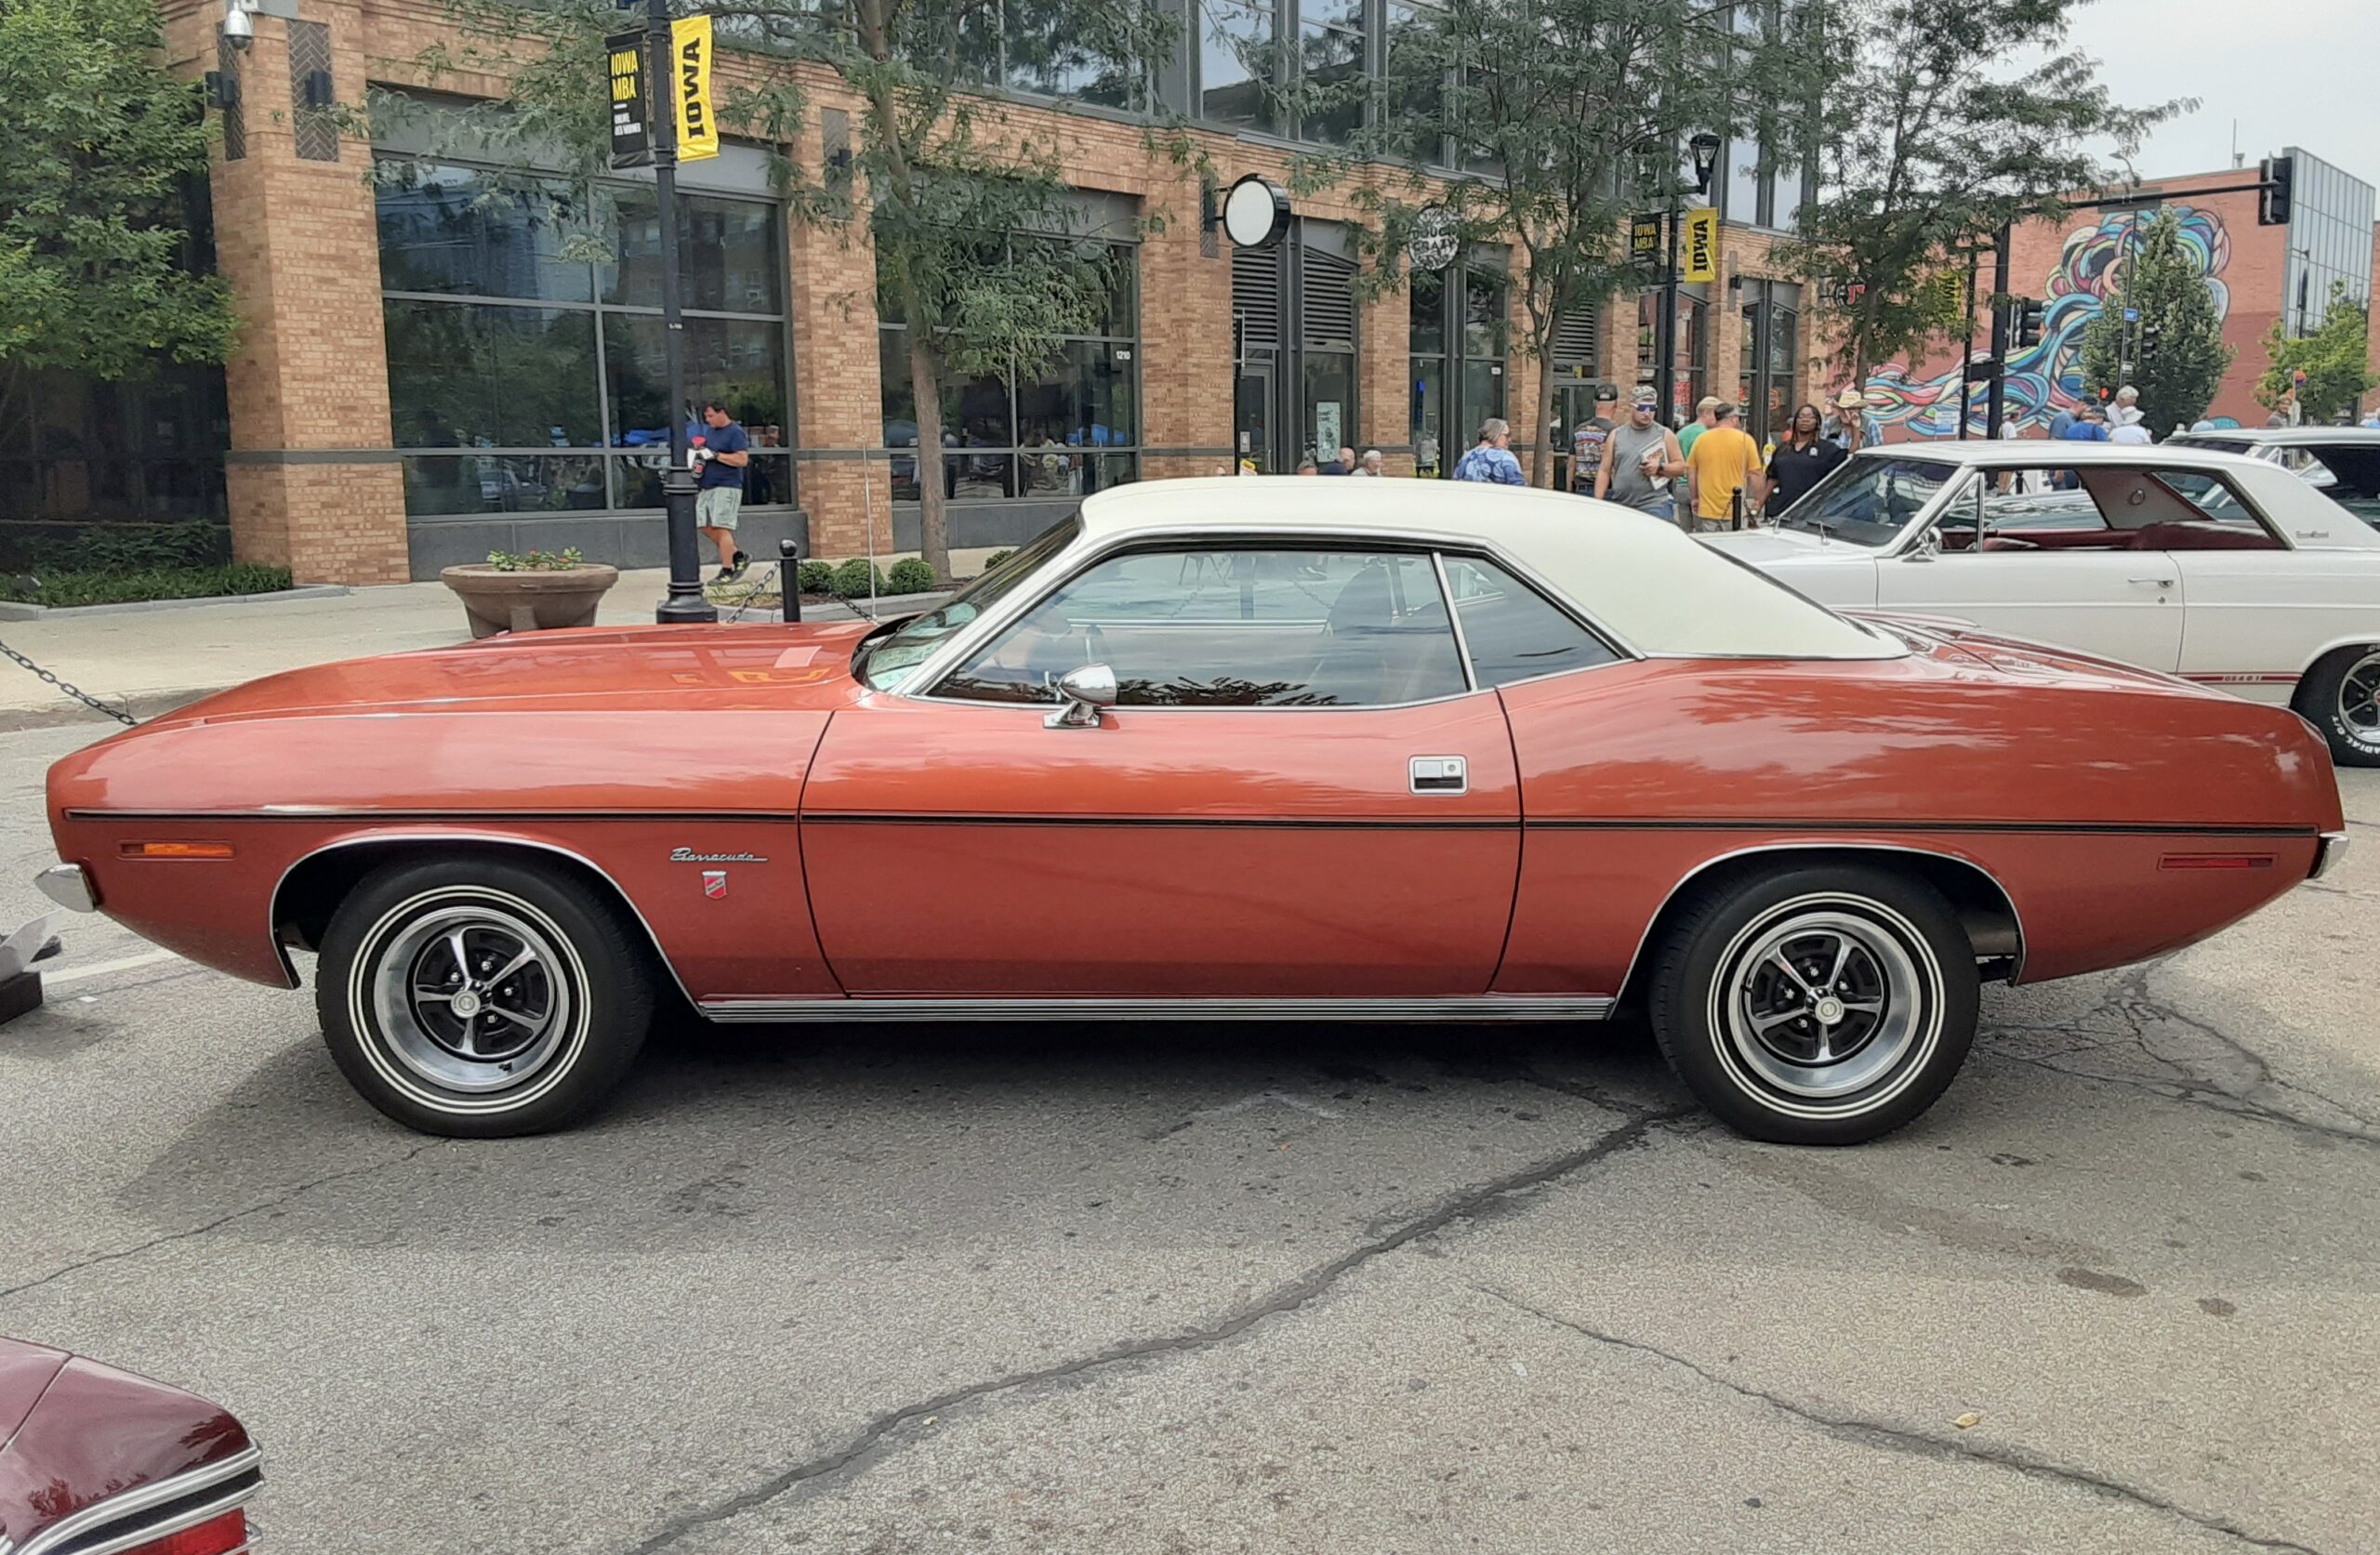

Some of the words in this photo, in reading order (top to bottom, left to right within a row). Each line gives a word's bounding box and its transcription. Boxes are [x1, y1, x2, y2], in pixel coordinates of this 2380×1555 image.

[611, 49, 639, 76] IOWA
[612, 75, 637, 101] MBA
[682, 37, 706, 138] IOWA
[1634, 222, 1657, 237] IOWA
[1634, 236, 1654, 250] MBA
[1692, 218, 1709, 272] IOWA
[670, 847, 769, 862] Barracuda
